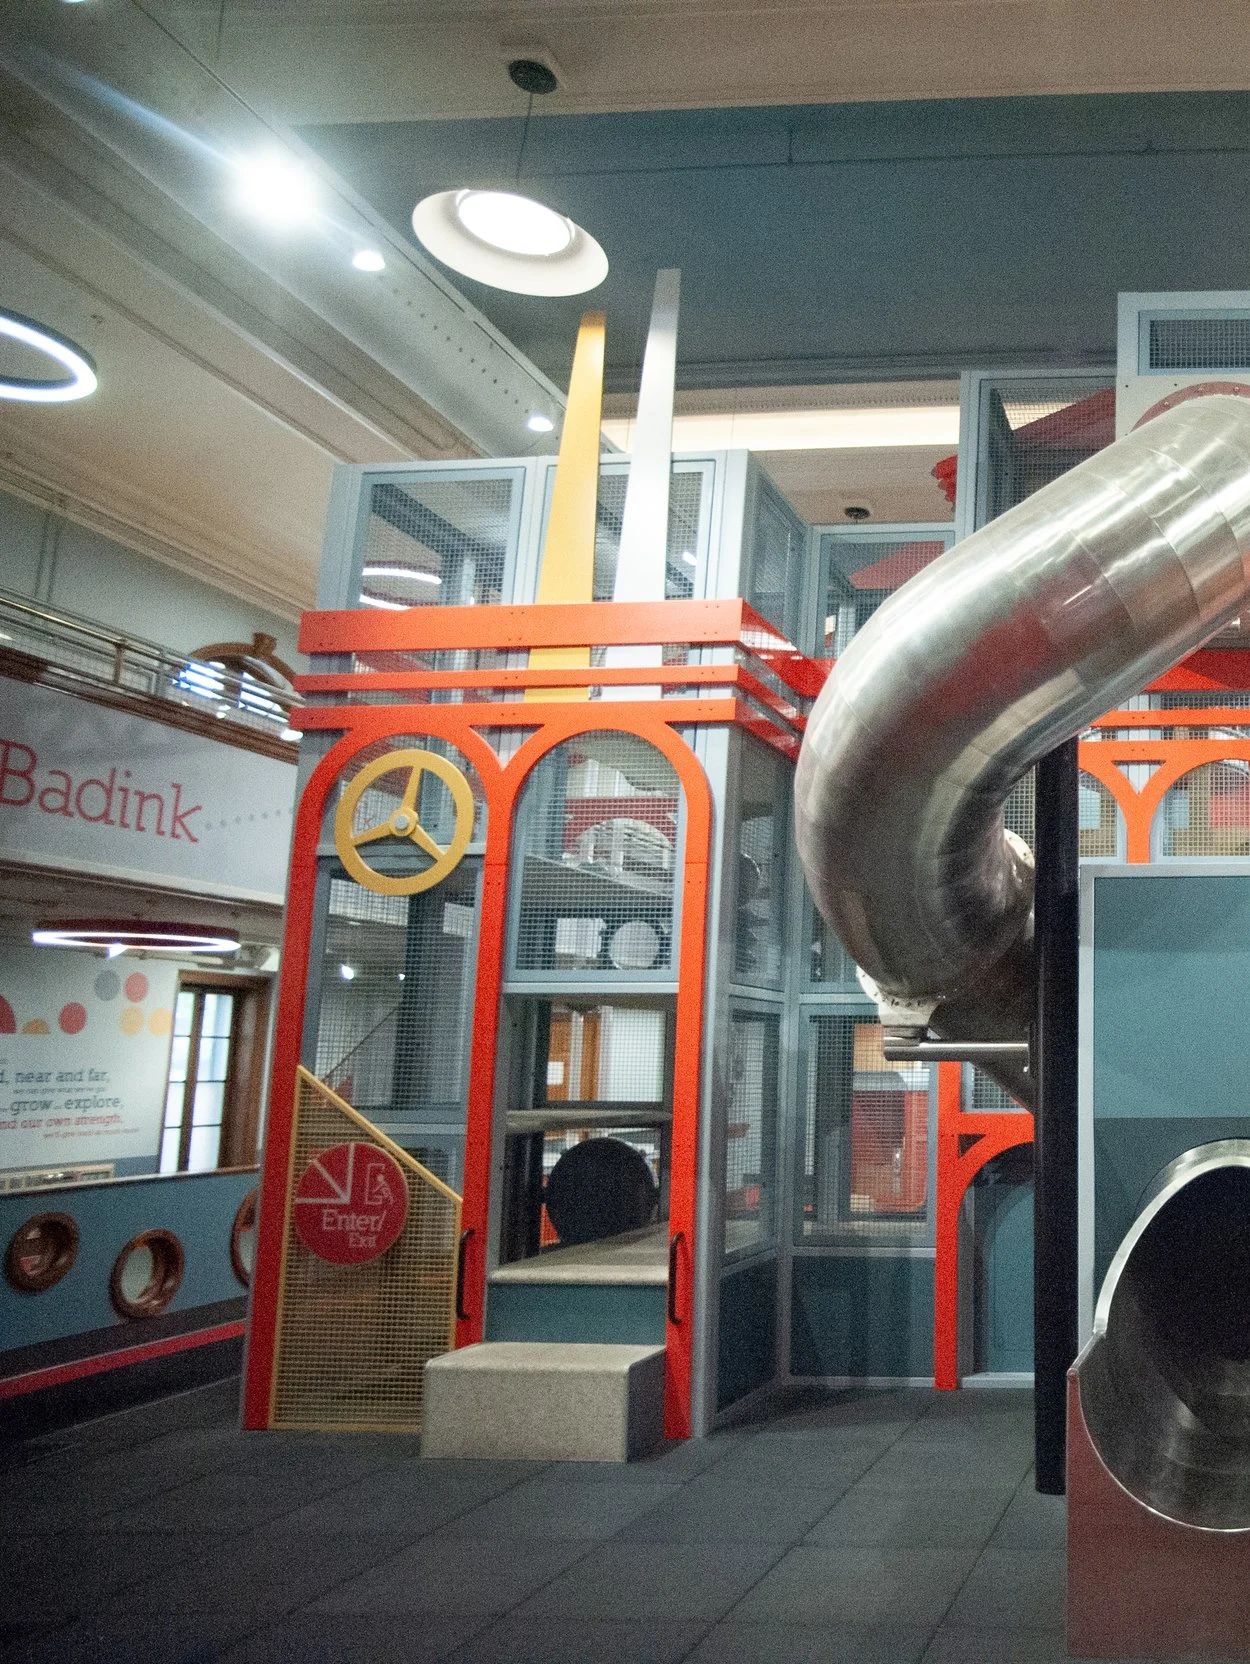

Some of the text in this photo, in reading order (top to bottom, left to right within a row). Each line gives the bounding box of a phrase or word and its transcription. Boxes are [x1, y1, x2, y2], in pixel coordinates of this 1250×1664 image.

[0, 739, 202, 843] Badink
[15, 1071, 53, 1083] near
[55, 1070, 84, 1083] and
[88, 1067, 111, 1084] far,
[10, 1095, 125, 1116] grow explore,
[20, 1119, 43, 1129] our
[45, 1117, 71, 1128] own
[322, 1208, 387, 1231] Enter/
[348, 1232, 377, 1249] Exit
